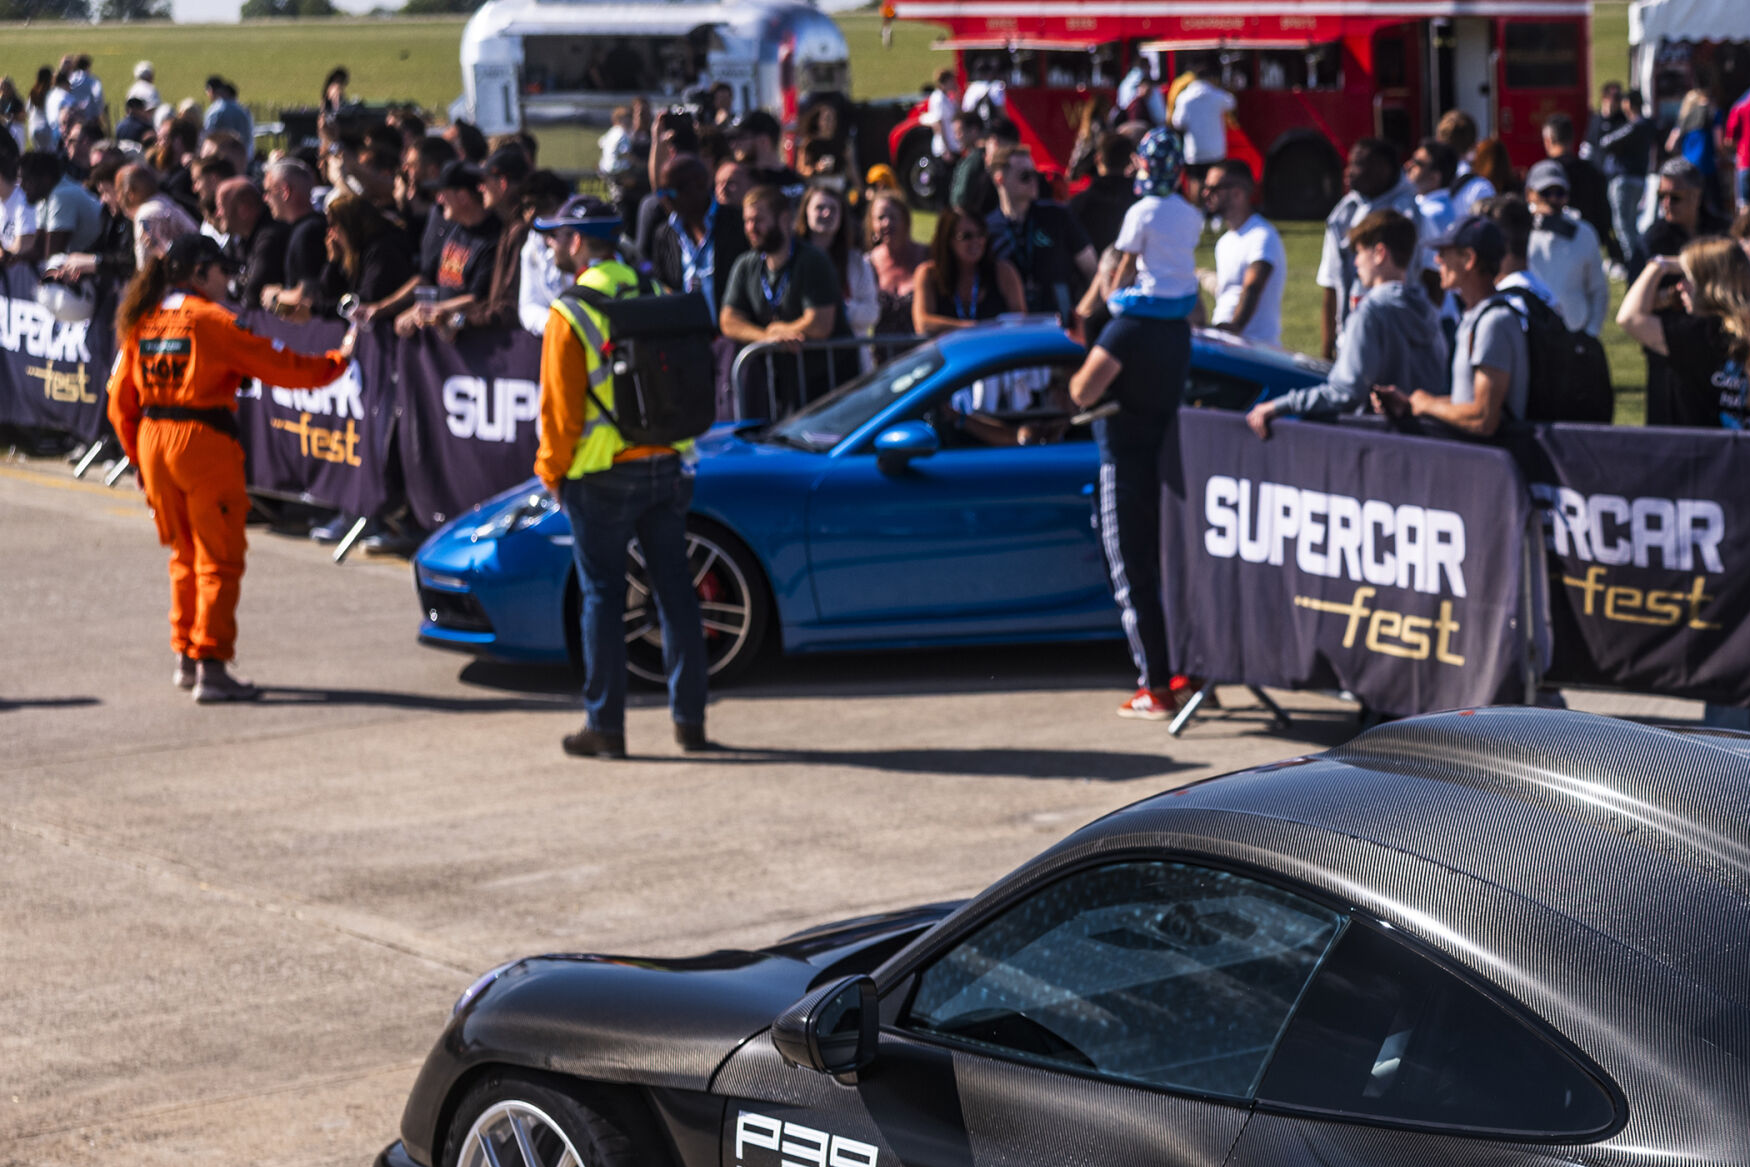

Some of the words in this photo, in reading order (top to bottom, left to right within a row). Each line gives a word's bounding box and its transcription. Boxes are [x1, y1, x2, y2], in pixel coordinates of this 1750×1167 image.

[28, 359, 97, 404] fest
[443, 374, 541, 443] SUP
[280, 411, 361, 467] fest
[1204, 475, 1467, 597] SUPERCAR
[1303, 586, 1465, 666] fest
[1561, 565, 1723, 630] fest
